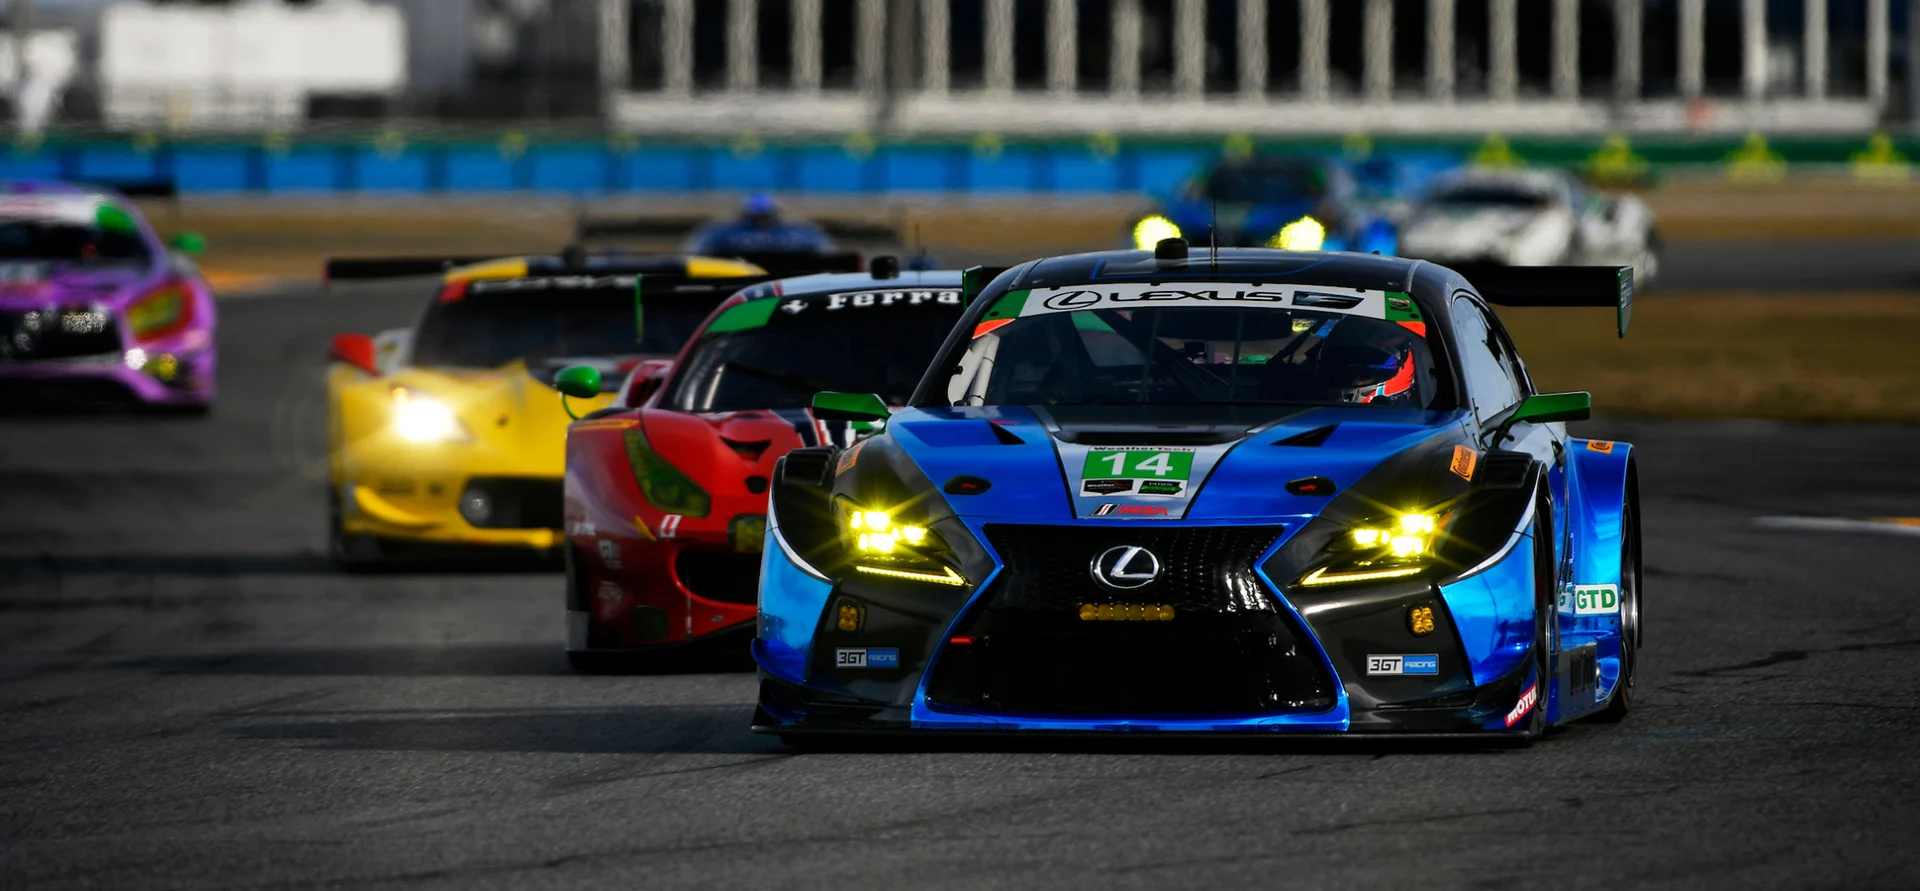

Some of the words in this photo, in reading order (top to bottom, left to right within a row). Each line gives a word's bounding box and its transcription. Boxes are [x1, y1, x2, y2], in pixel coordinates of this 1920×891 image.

[1110, 290, 1283, 302] LEXUS
[1102, 452, 1173, 475] 14
[1116, 506, 1168, 516] IMSA
[1577, 589, 1615, 609] GTD
[838, 652, 865, 664] 3GT
[1370, 659, 1401, 671] 3GT
